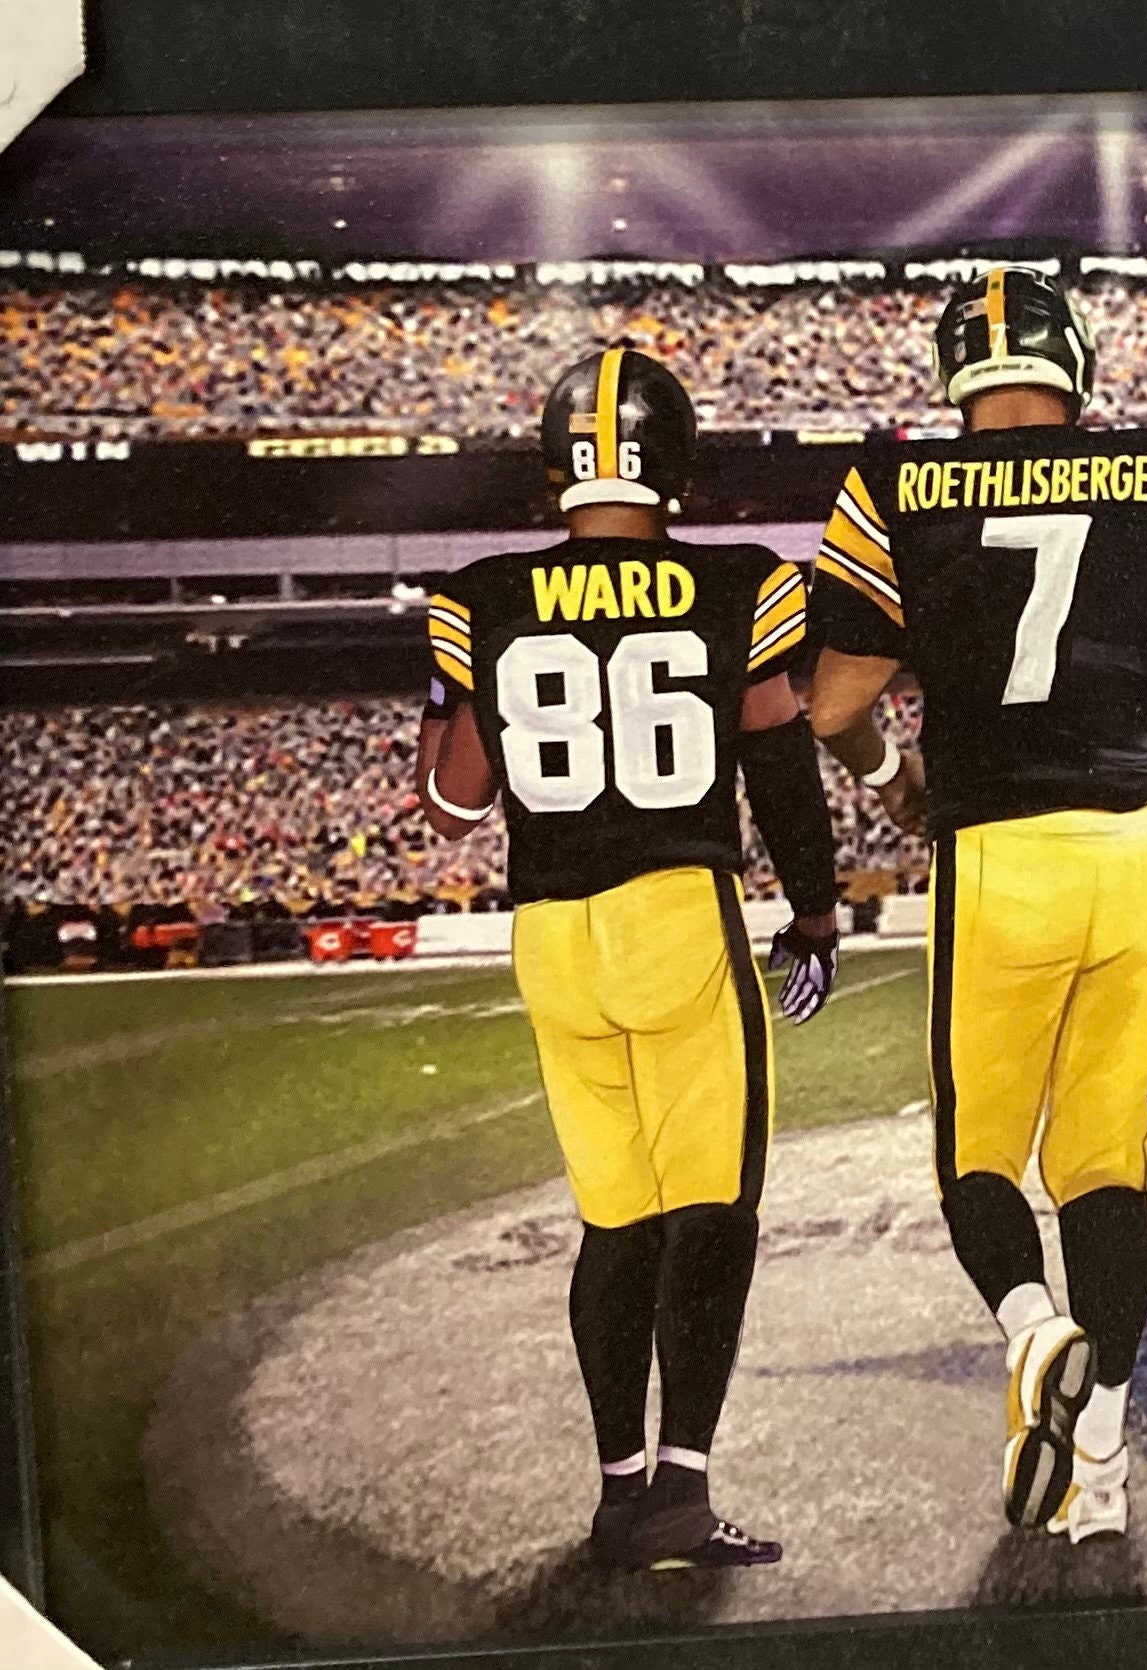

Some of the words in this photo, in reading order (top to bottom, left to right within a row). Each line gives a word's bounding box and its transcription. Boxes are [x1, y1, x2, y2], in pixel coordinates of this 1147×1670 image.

[990, 323, 1007, 359] 7
[572, 441, 641, 480] 86
[531, 560, 695, 622] WARD
[981, 513, 1093, 705] 7
[496, 630, 716, 813] 86
